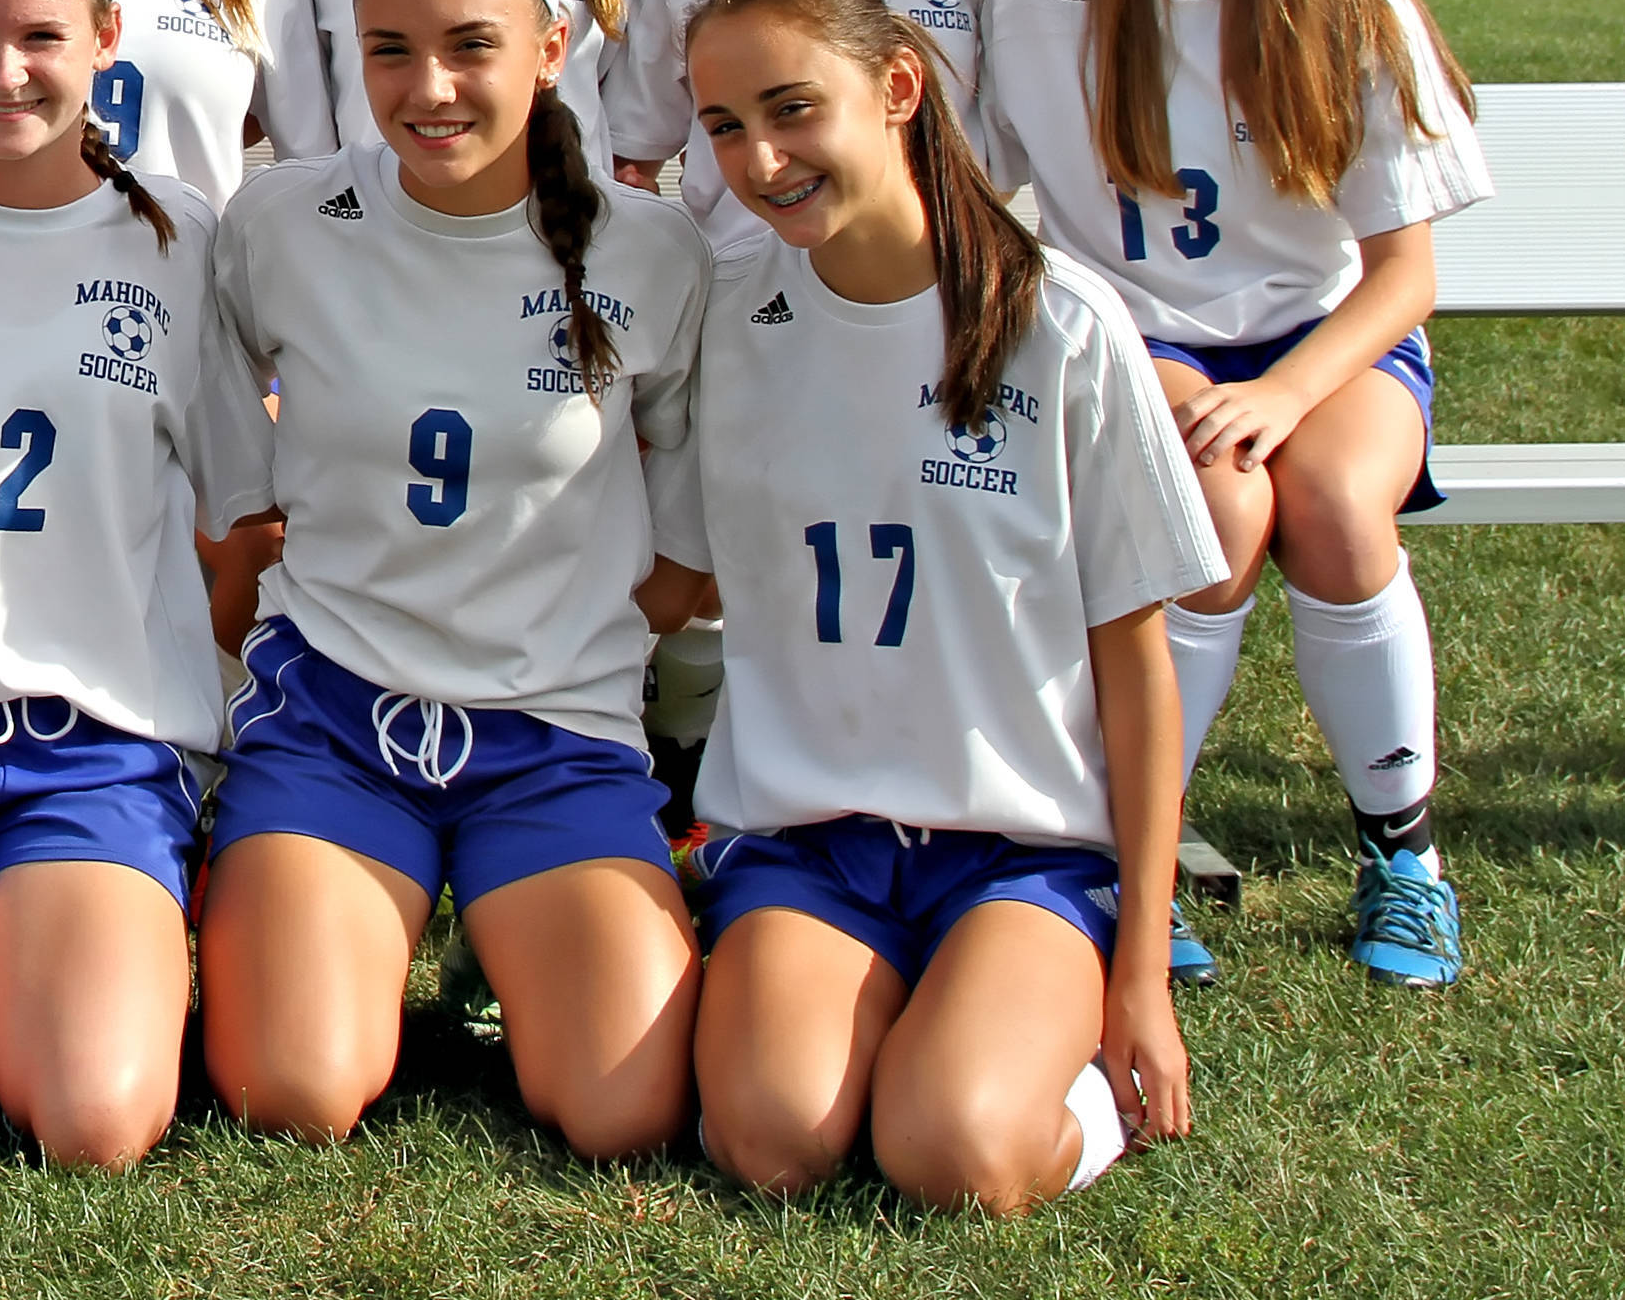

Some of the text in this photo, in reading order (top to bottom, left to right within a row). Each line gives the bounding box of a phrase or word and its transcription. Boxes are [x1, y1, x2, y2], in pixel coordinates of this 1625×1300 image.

[157, 15, 233, 46] SOCCER
[908, 9, 972, 32] SOCCER
[91, 60, 145, 164] 9
[318, 204, 364, 220] adidas
[1106, 168, 1221, 261] 13
[74, 280, 172, 337] MAHOPAC
[520, 289, 635, 332] MAOPAC
[751, 311, 794, 325] adidas
[78, 353, 159, 396] SOCCER
[918, 382, 1040, 425] MPAC
[406, 407, 473, 528] 9
[921, 459, 1018, 496] SOCCER
[804, 521, 915, 647] 17
